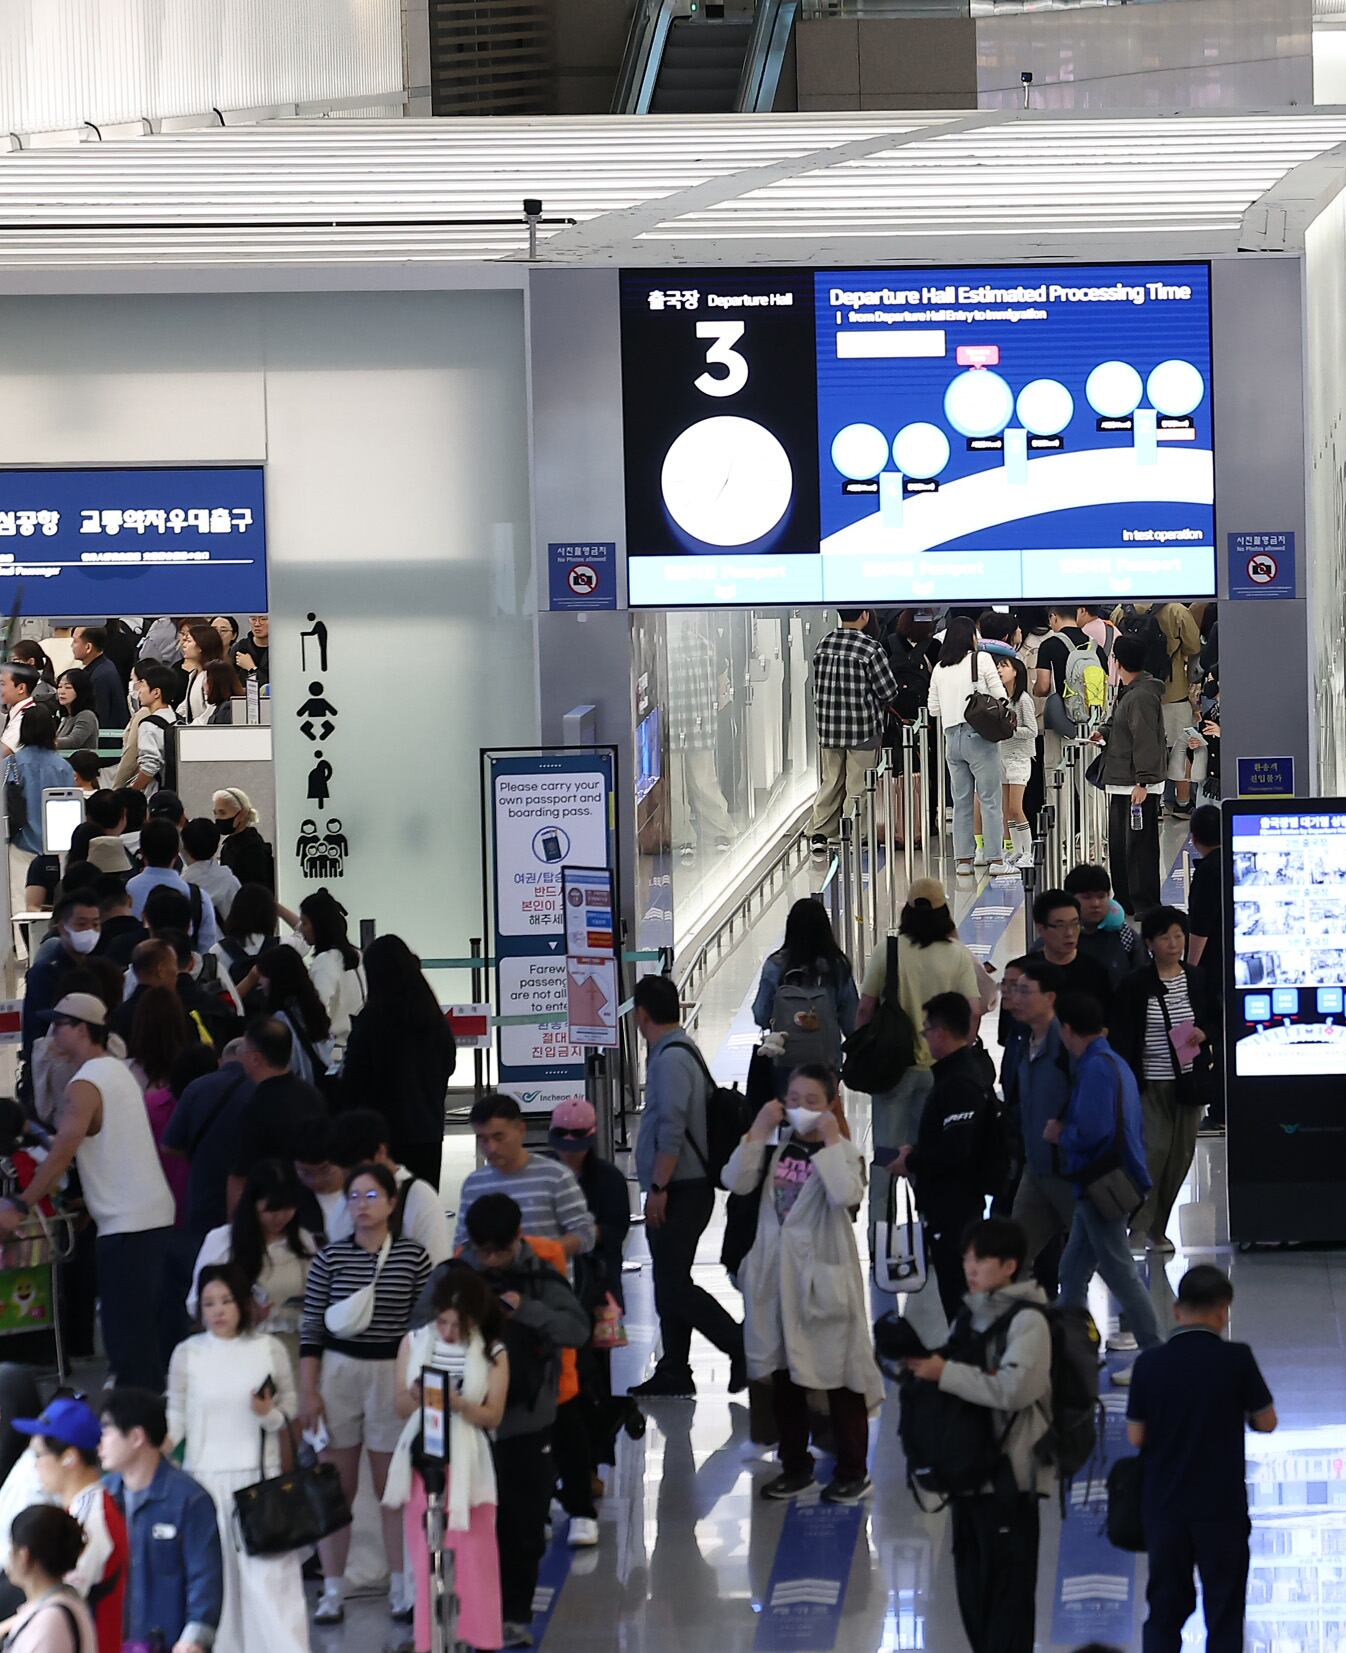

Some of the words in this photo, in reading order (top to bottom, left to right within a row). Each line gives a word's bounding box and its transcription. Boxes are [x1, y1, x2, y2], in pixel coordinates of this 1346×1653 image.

[648, 290, 700, 310] 출국장
[707, 294, 769, 308] Departure
[770, 293, 793, 305] Hall
[830, 288, 920, 308] Departure
[922, 286, 955, 304] Hall
[958, 285, 1047, 304] Estimated
[1049, 283, 1145, 304] Processing
[1147, 282, 1191, 300] Time
[694, 320, 749, 398] 3
[1237, 536, 1286, 545] 사진촬영금지
[557, 546, 607, 556] 사진촬영금지
[500, 782, 538, 792] Please
[541, 782, 572, 793] carry
[574, 781, 600, 792] your
[499, 797, 523, 806] own
[525, 795, 577, 806] passport
[580, 793, 601, 803] and
[508, 807, 559, 818] boarding
[562, 807, 592, 819] pass.
[521, 900, 555, 912] 본인이
[510, 991, 529, 1000] are
[532, 990, 551, 999] not
[531, 1002, 542, 1011] to
[542, 1032, 568, 1044] 절대
[532, 1046, 582, 1058] 진입금지
